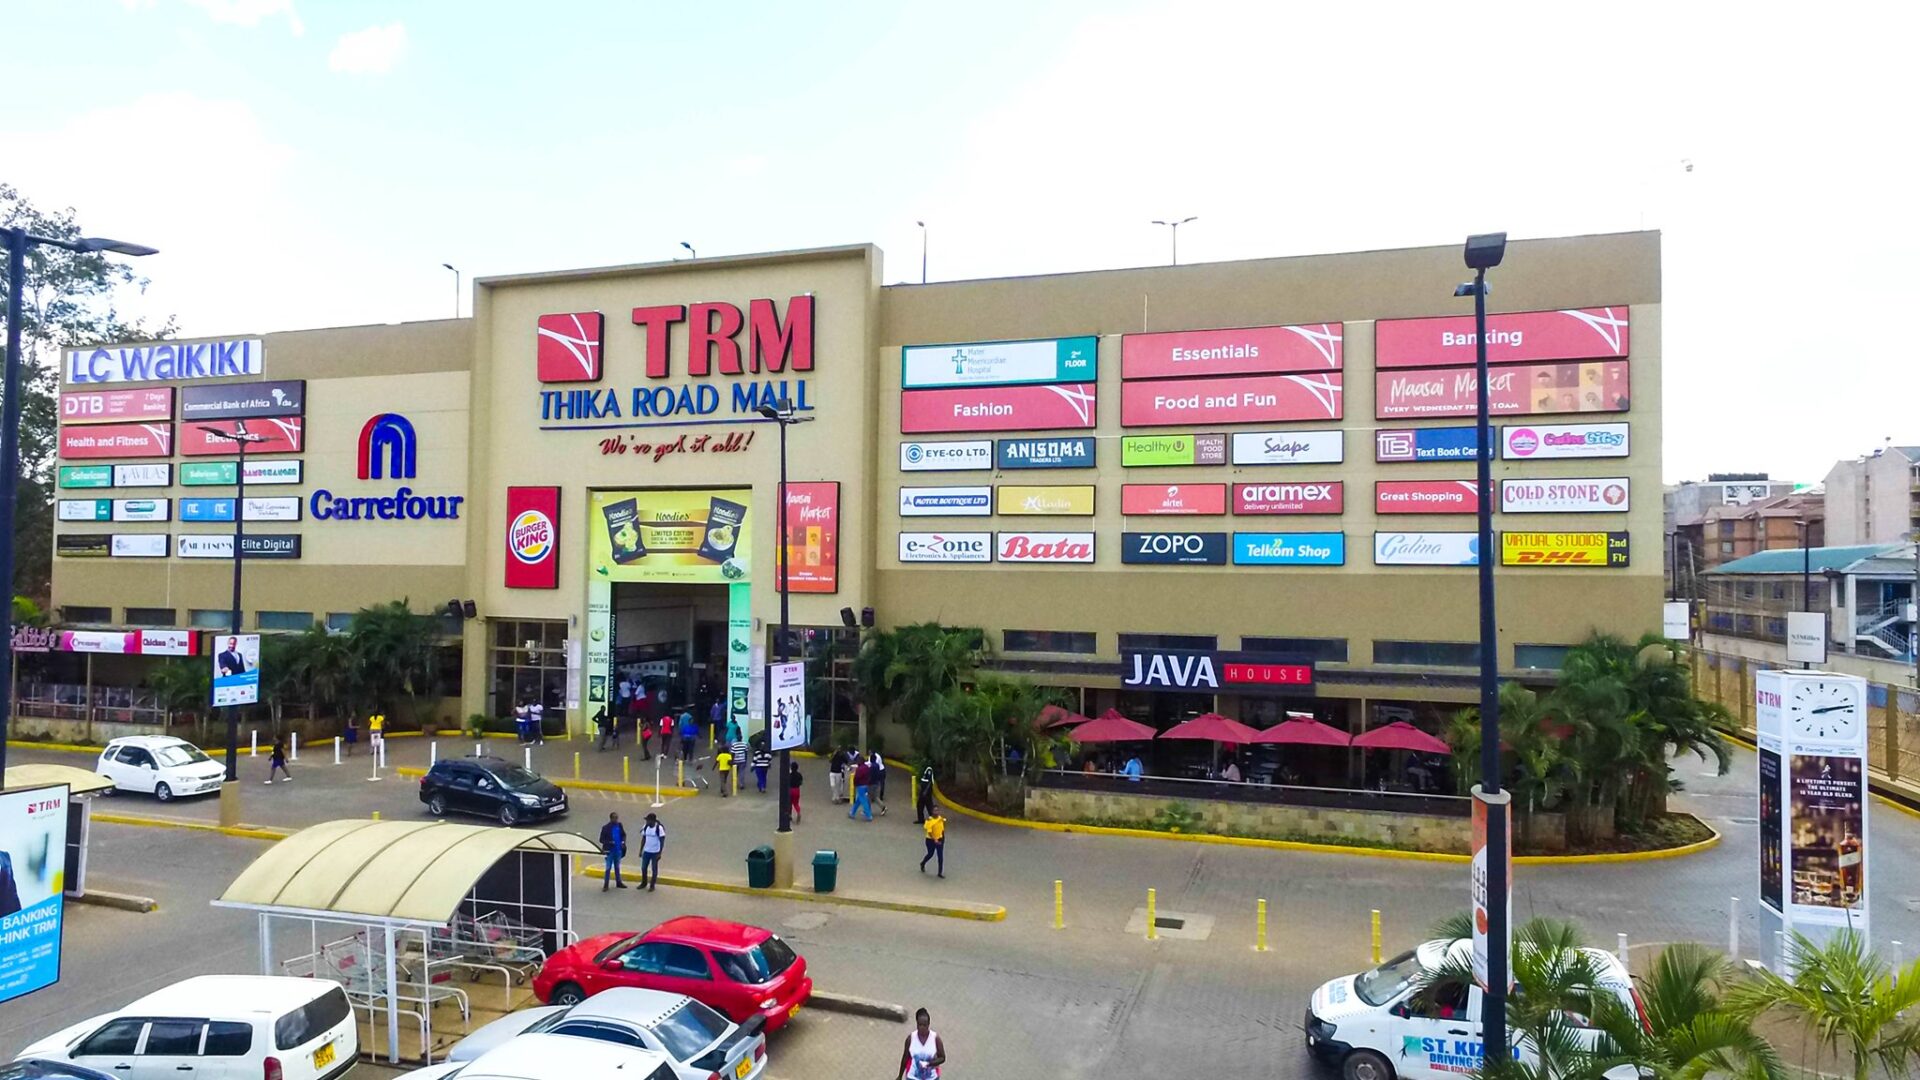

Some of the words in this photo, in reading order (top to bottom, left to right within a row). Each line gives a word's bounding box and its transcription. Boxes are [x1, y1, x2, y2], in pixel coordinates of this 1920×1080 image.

[632, 295, 815, 378] TRM
[1172, 344, 1260, 361] Essentials
[72, 349, 112, 382] LC
[1390, 377, 1444, 404] Maasai
[1454, 372, 1516, 400] Maket
[65, 395, 104, 414] DTB
[184, 401, 222, 411] Commercial
[223, 400, 240, 409] Bank
[241, 400, 249, 408] of
[250, 399, 270, 408] Africa
[540, 388, 621, 419] THIKA
[632, 384, 720, 417] ROAD
[732, 380, 815, 413] MALL
[1155, 395, 1199, 409] Food
[1205, 393, 1237, 408] and
[1244, 393, 1276, 406] Fun
[954, 402, 1013, 416] Fashion
[66, 437, 94, 447] Health
[97, 437, 115, 446] and
[116, 436, 148, 445] Fitness
[206, 433, 259, 443] Electrnics
[599, 434, 652, 455] We've
[653, 434, 687, 463] got
[689, 434, 712, 453] it
[712, 430, 755, 453] all!
[926, 449, 963, 457] EYE-CO
[1128, 441, 1171, 453] Healthy
[1264, 437, 1310, 456] Saape
[1416, 448, 1435, 457] Text
[1437, 447, 1460, 456] Book
[1462, 446, 1493, 456] Cene
[1242, 484, 1332, 501] aramex
[1380, 492, 1409, 501] Great
[1412, 492, 1463, 502] Shopping
[1505, 485, 1544, 503] COLD
[1548, 484, 1599, 502] STONE
[310, 487, 464, 520] Carrefour
[915, 497, 939, 505] MOTOR
[940, 497, 972, 506] BOUTIQUE
[973, 497, 986, 505] LTD
[1162, 498, 1183, 507] airtel
[1244, 502, 1270, 511] delivery
[515, 521, 547, 538] BURGER
[241, 539, 261, 549] Elite
[263, 539, 294, 551] Digital
[516, 530, 548, 550] KING
[1000, 535, 1091, 559] Bata
[1139, 535, 1203, 553] ZOPO
[1505, 535, 1550, 547] VIRTUAL
[1555, 534, 1604, 547] STUDIOS
[1609, 538, 1627, 547] 2nd
[1247, 544, 1294, 557] Telkom
[1297, 545, 1331, 559] Shop
[1517, 551, 1592, 563] DHL
[1612, 553, 1627, 562] Flr
[1125, 653, 1219, 687] JAVA
[1230, 668, 1302, 680] HOUSE
[1764, 691, 1781, 708] TRM
[39, 798, 61, 811] TRM
[3, 903, 57, 930] BANKING
[32, 918, 57, 935] TRM
[1422, 1037, 1450, 1054] ST.
[1430, 1053, 1473, 1068] DRIVING
